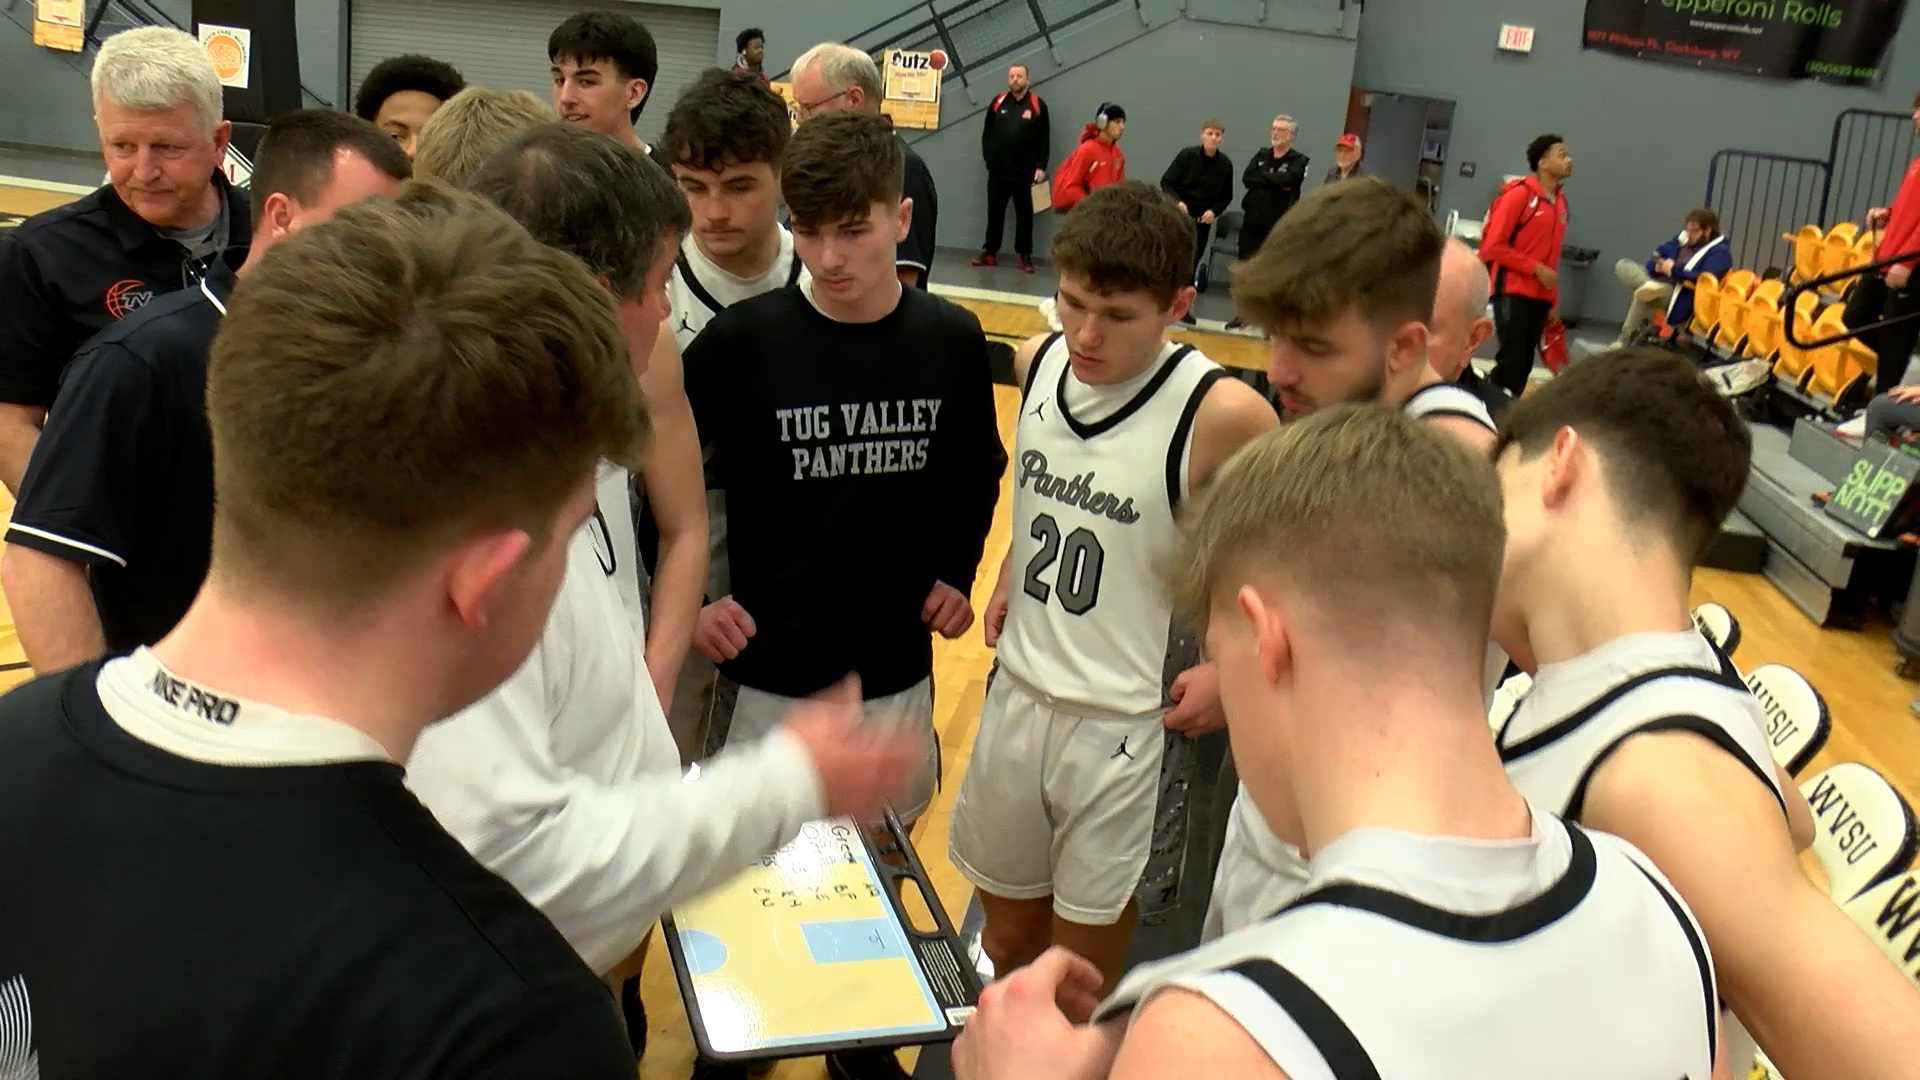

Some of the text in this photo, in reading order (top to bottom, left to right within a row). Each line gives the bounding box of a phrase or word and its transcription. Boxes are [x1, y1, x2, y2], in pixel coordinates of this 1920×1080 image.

[1783, 1, 1842, 28] Rolls
[1505, 28, 1528, 48] EXIT
[775, 398, 942, 442] TUG VALLEY
[792, 438, 930, 480] PANTHERS
[1846, 458, 1907, 502] SLIPP
[1019, 449, 1141, 525] Panthers
[1024, 512, 1105, 616] 20
[183, 685, 241, 726] PRO
[1808, 774, 1878, 866] WVSU
